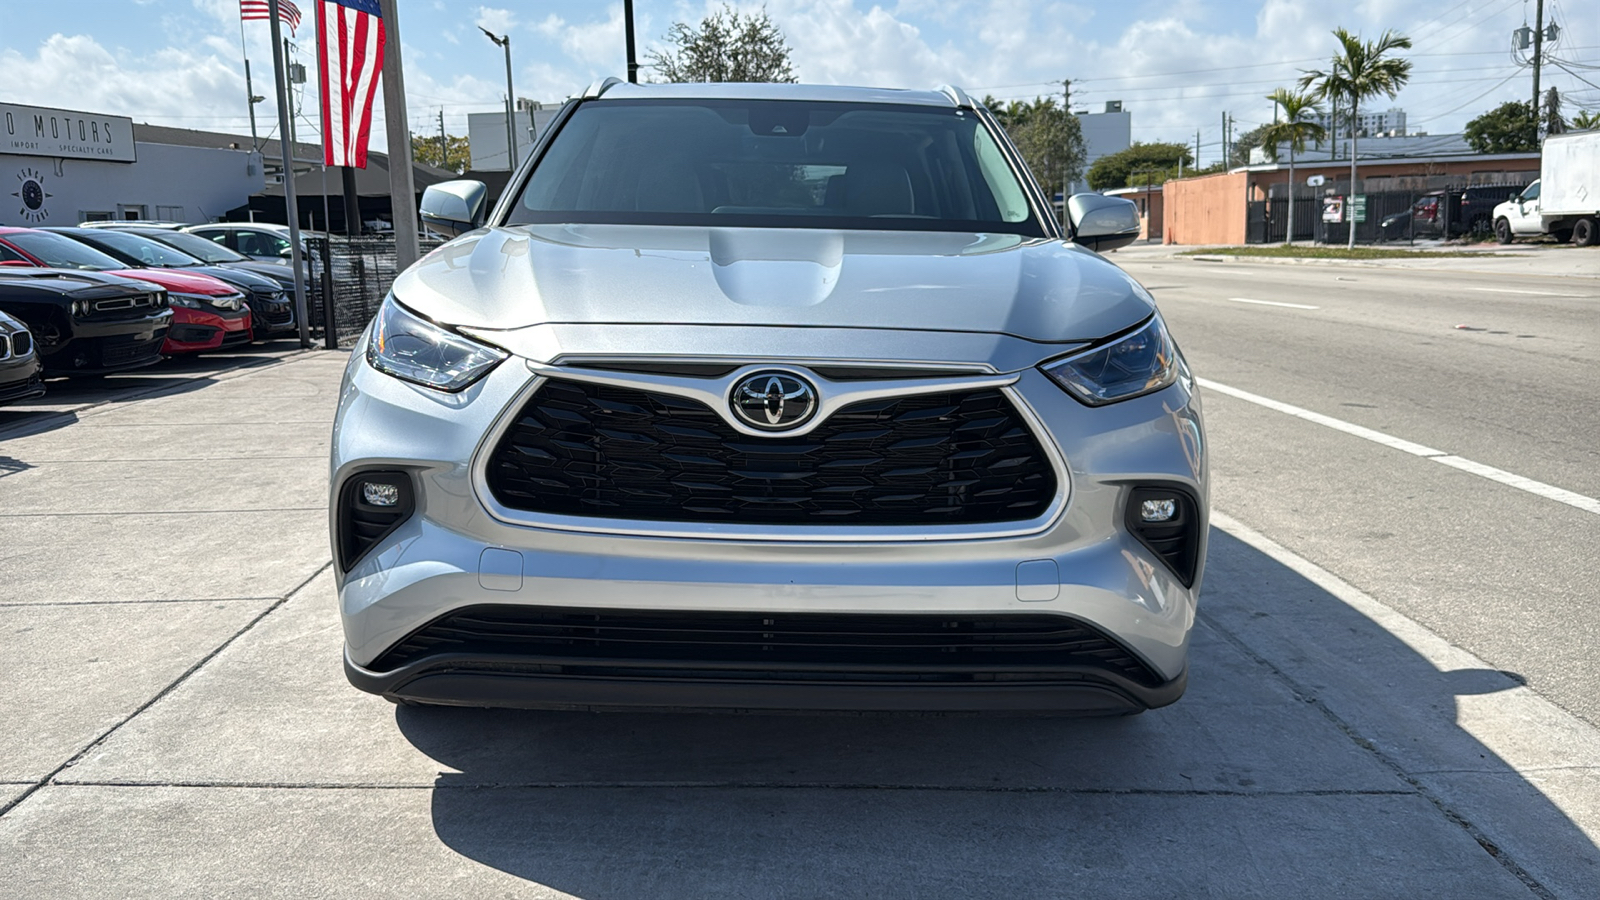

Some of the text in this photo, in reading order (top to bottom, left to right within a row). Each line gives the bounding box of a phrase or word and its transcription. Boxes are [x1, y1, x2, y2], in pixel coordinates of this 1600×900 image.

[34, 114, 112, 144] MOTORS
[11, 141, 113, 155] IMPORT SPECIALTY CARS
